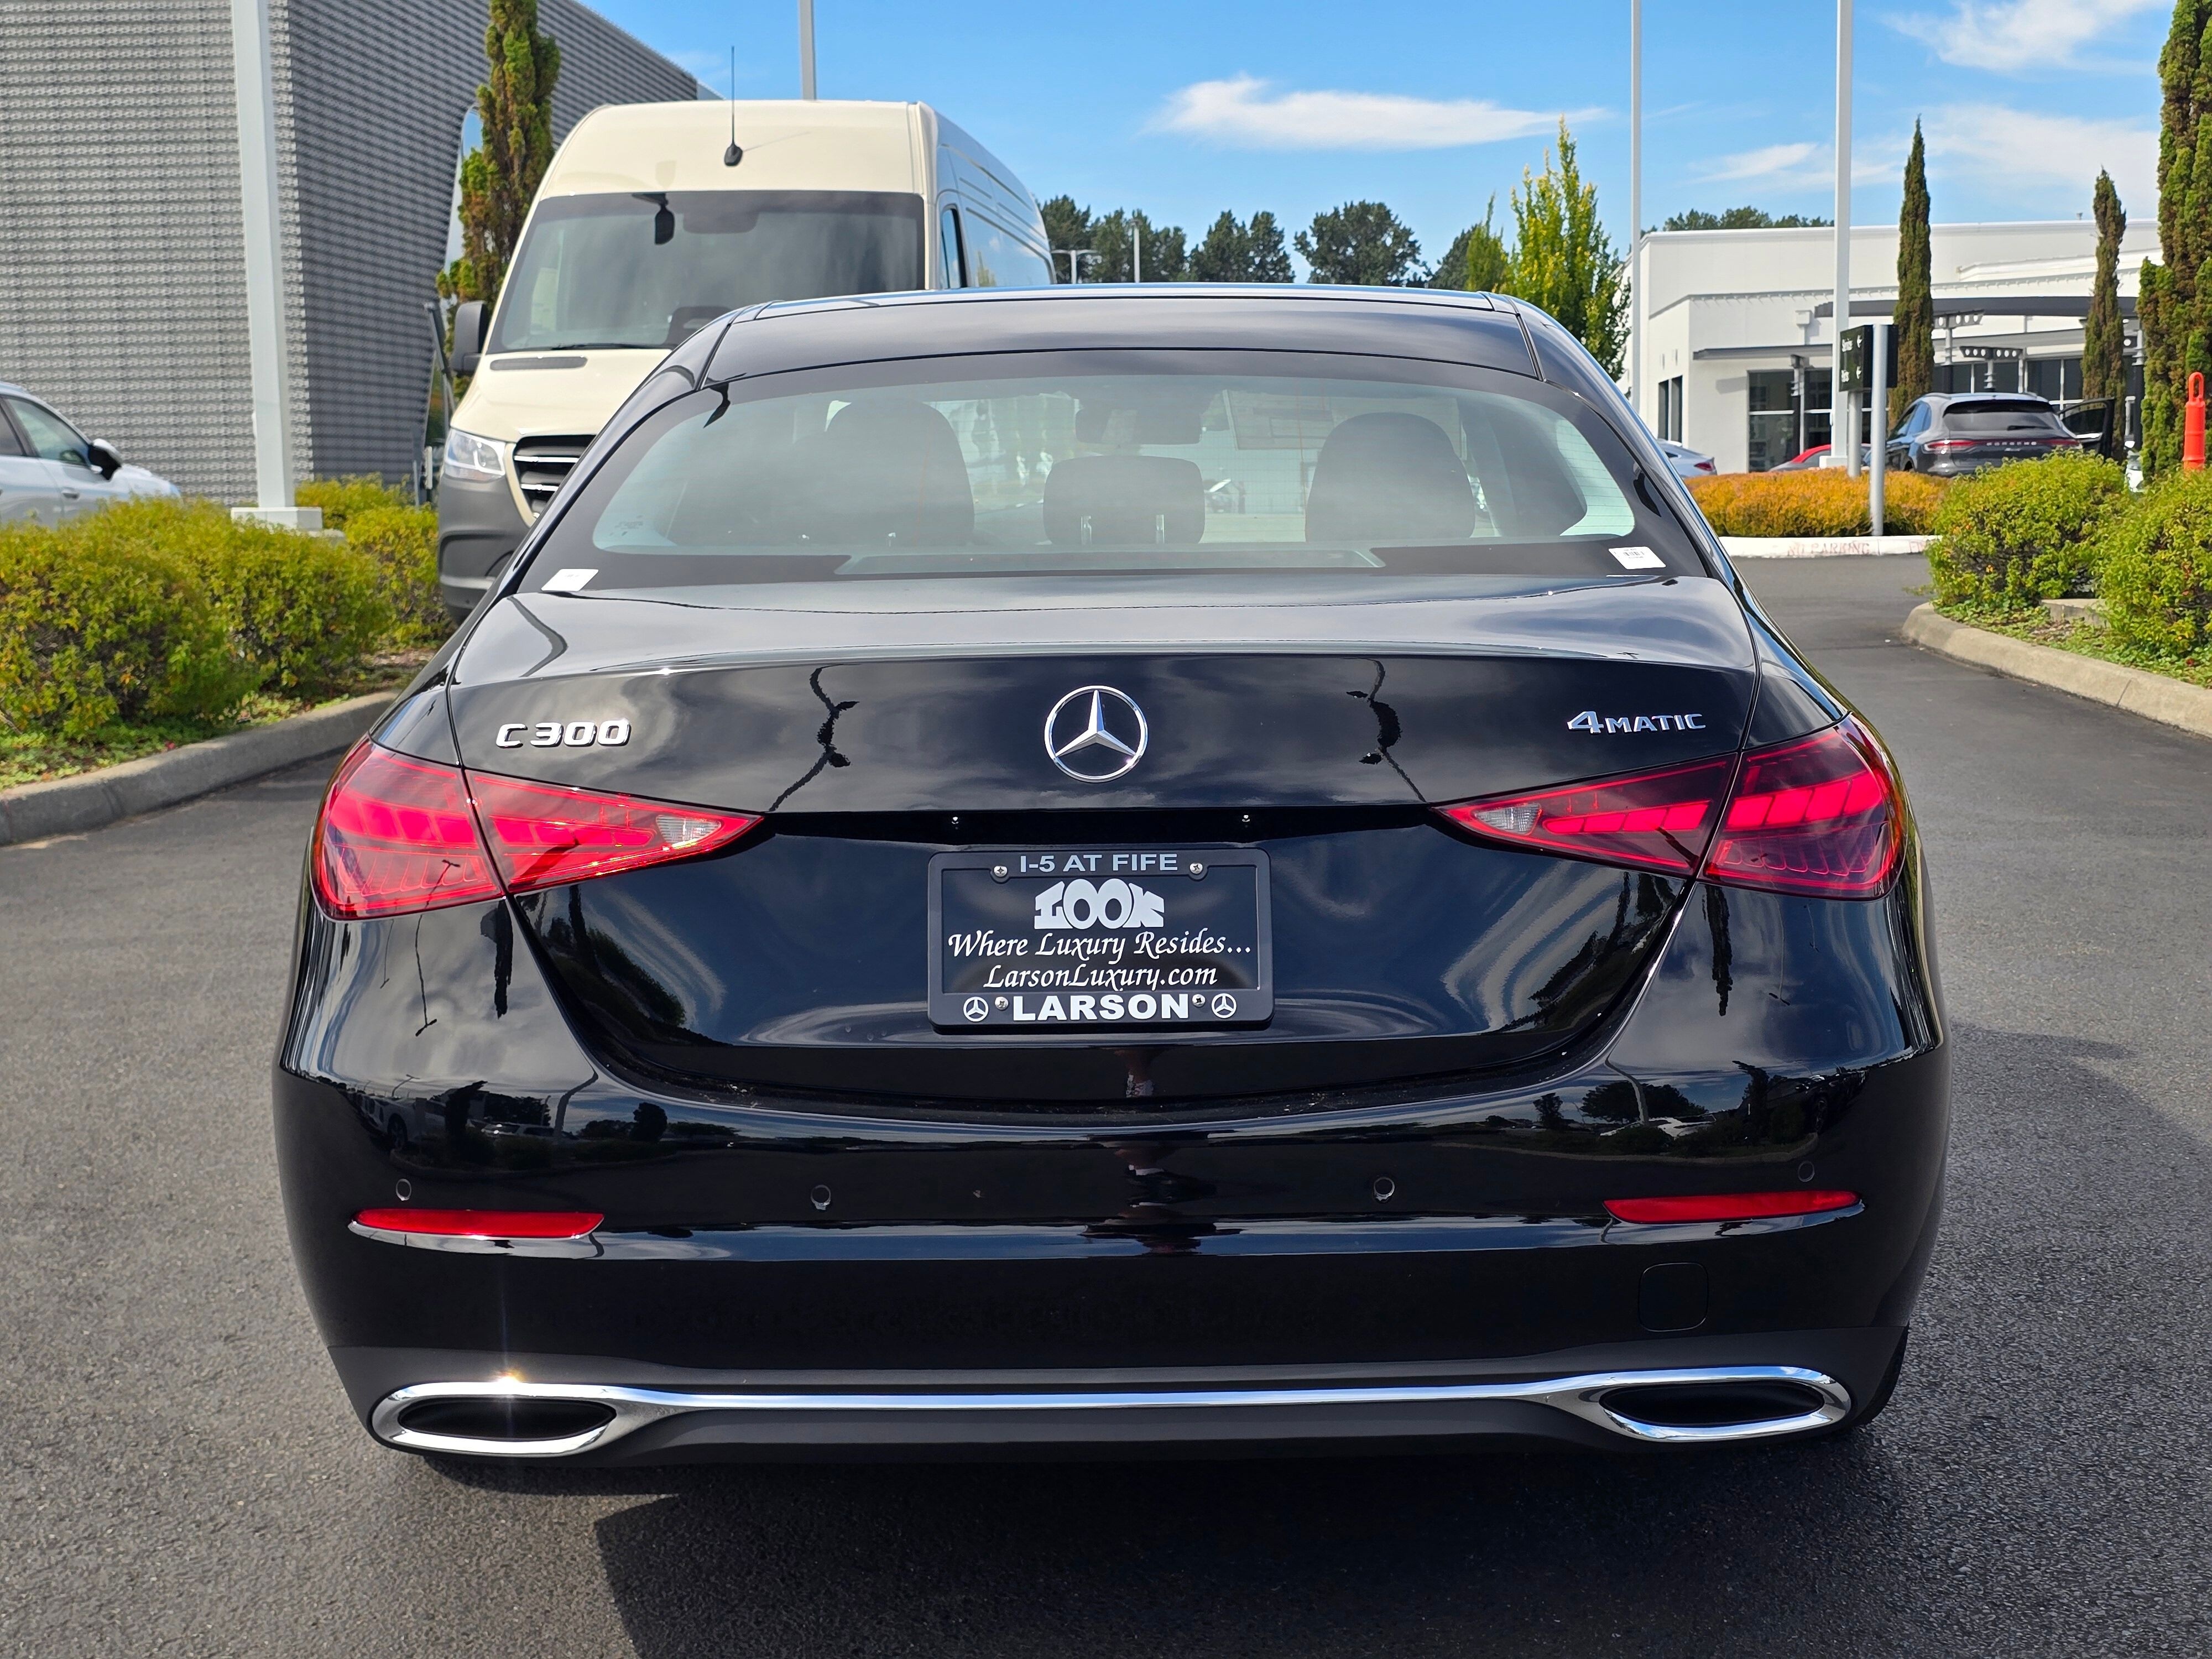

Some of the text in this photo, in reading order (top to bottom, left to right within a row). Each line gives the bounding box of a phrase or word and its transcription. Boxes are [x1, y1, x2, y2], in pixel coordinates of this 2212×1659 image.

[1567, 711, 1707, 734] 4MATIC
[1020, 853, 1178, 872] I-5 AT FIFE
[948, 928, 1251, 964] Where Luxury Resides...
[983, 964, 1218, 992] LarsonLuxury.com
[1013, 994, 1189, 1021] LARSON
